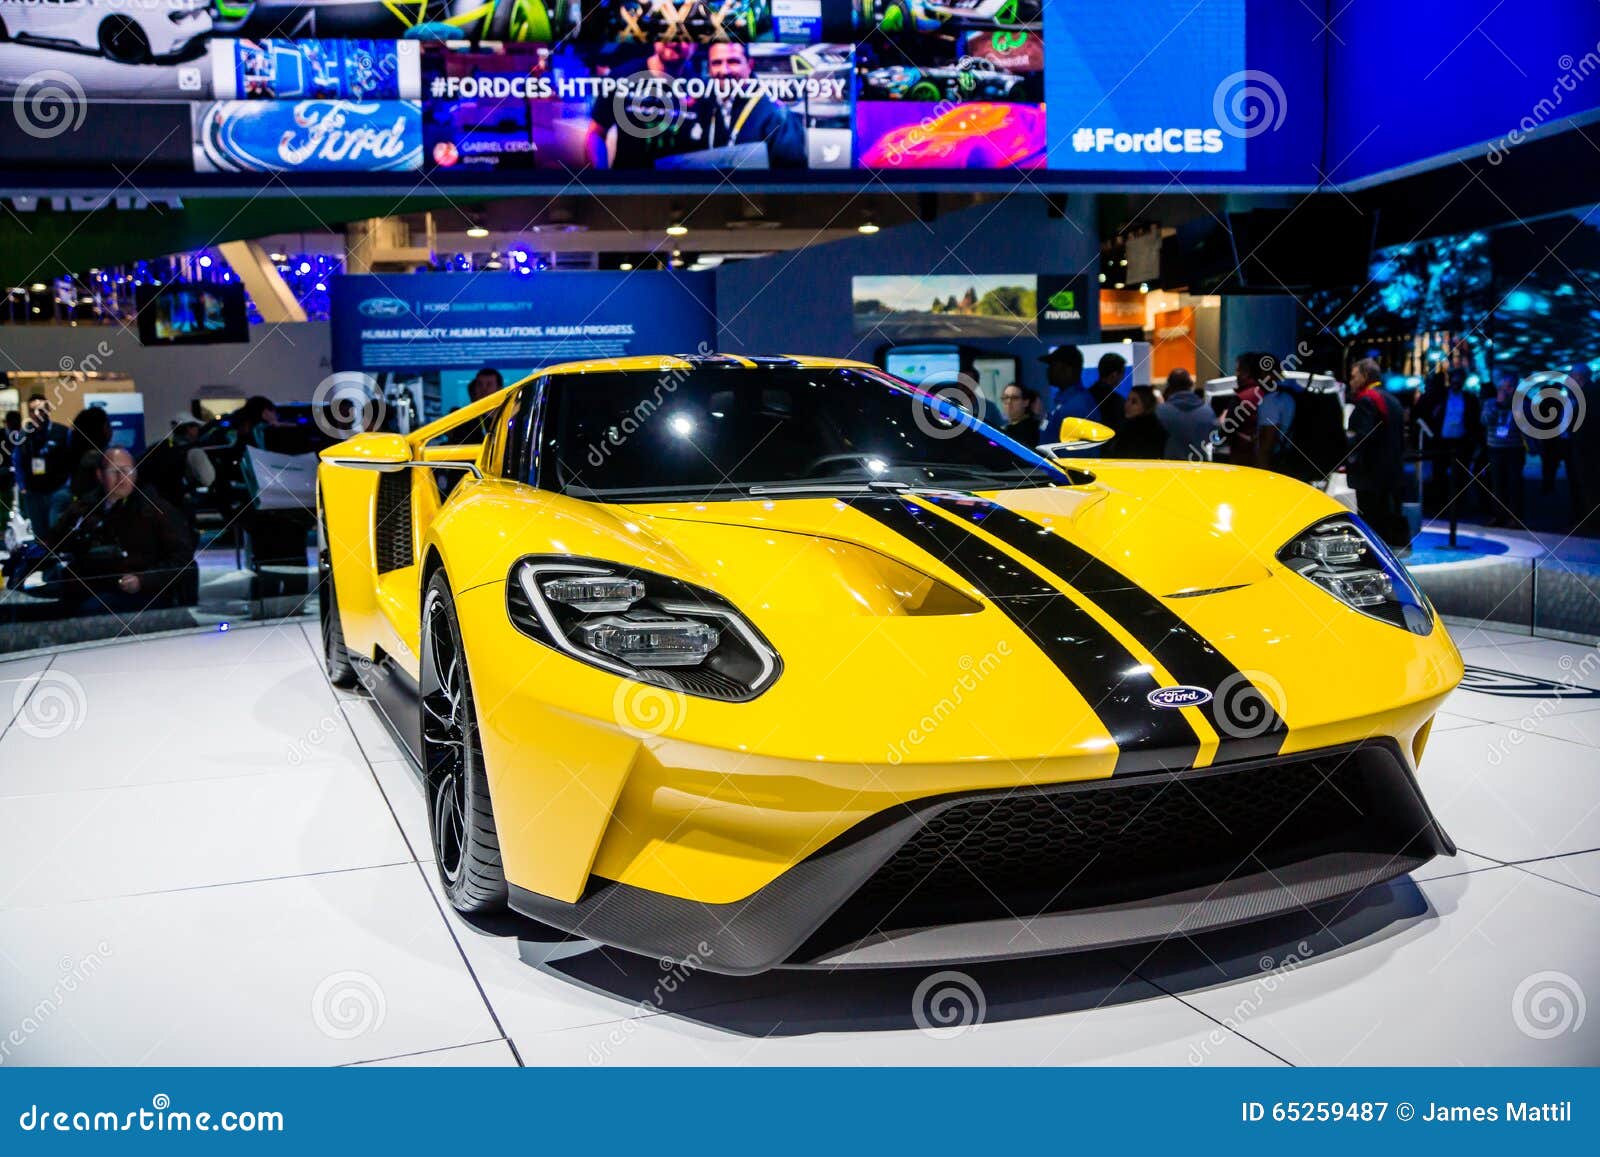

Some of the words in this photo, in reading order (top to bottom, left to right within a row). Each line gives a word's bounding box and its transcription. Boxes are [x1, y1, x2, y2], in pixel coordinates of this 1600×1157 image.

[431, 77, 552, 98] #FORDCES
[278, 100, 407, 164] Ford
[1072, 127, 1223, 154] #FordCES
[1044, 310, 1081, 320] NVIDIA
[361, 329, 400, 340] HUMAN
[449, 327, 487, 338] HUMAN
[545, 326, 582, 336] HUMAN
